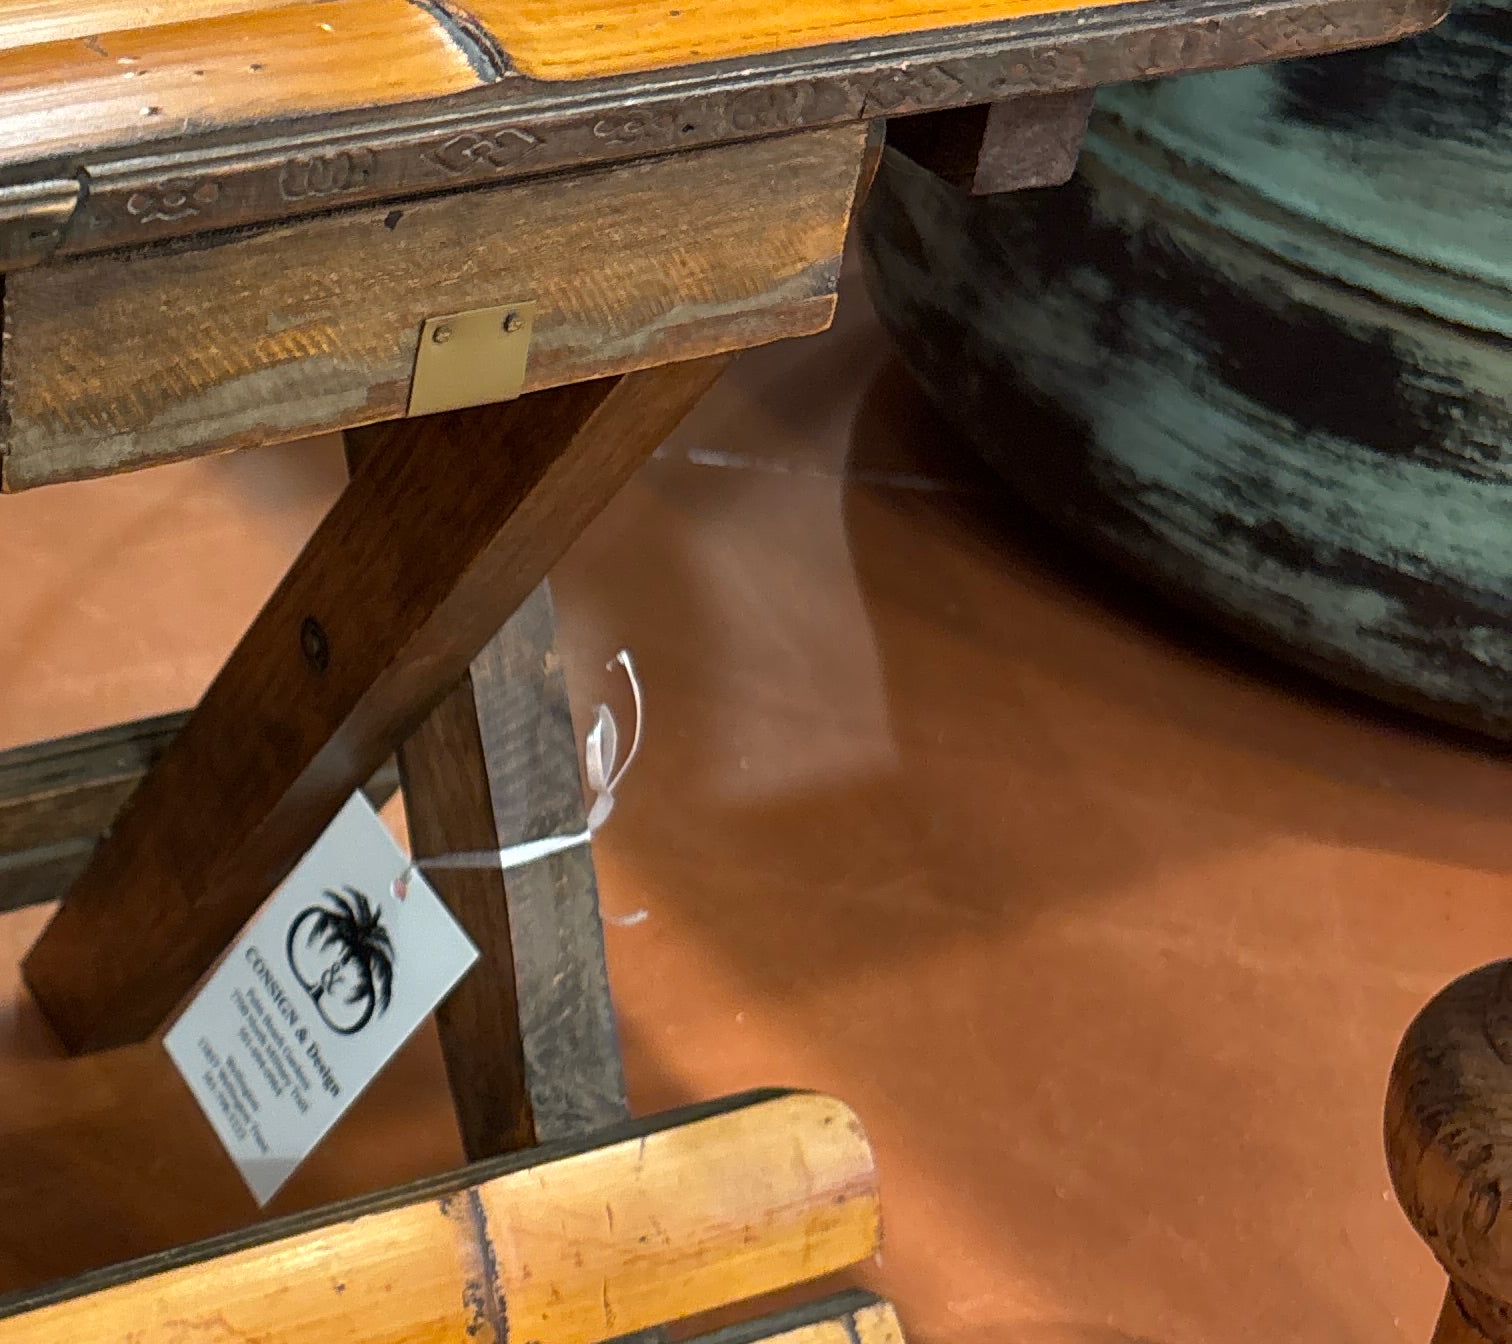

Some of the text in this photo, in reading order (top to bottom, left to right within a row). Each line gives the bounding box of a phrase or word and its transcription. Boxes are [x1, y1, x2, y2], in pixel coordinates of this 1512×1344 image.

[244, 945, 340, 1097] CONSIGN & Design
